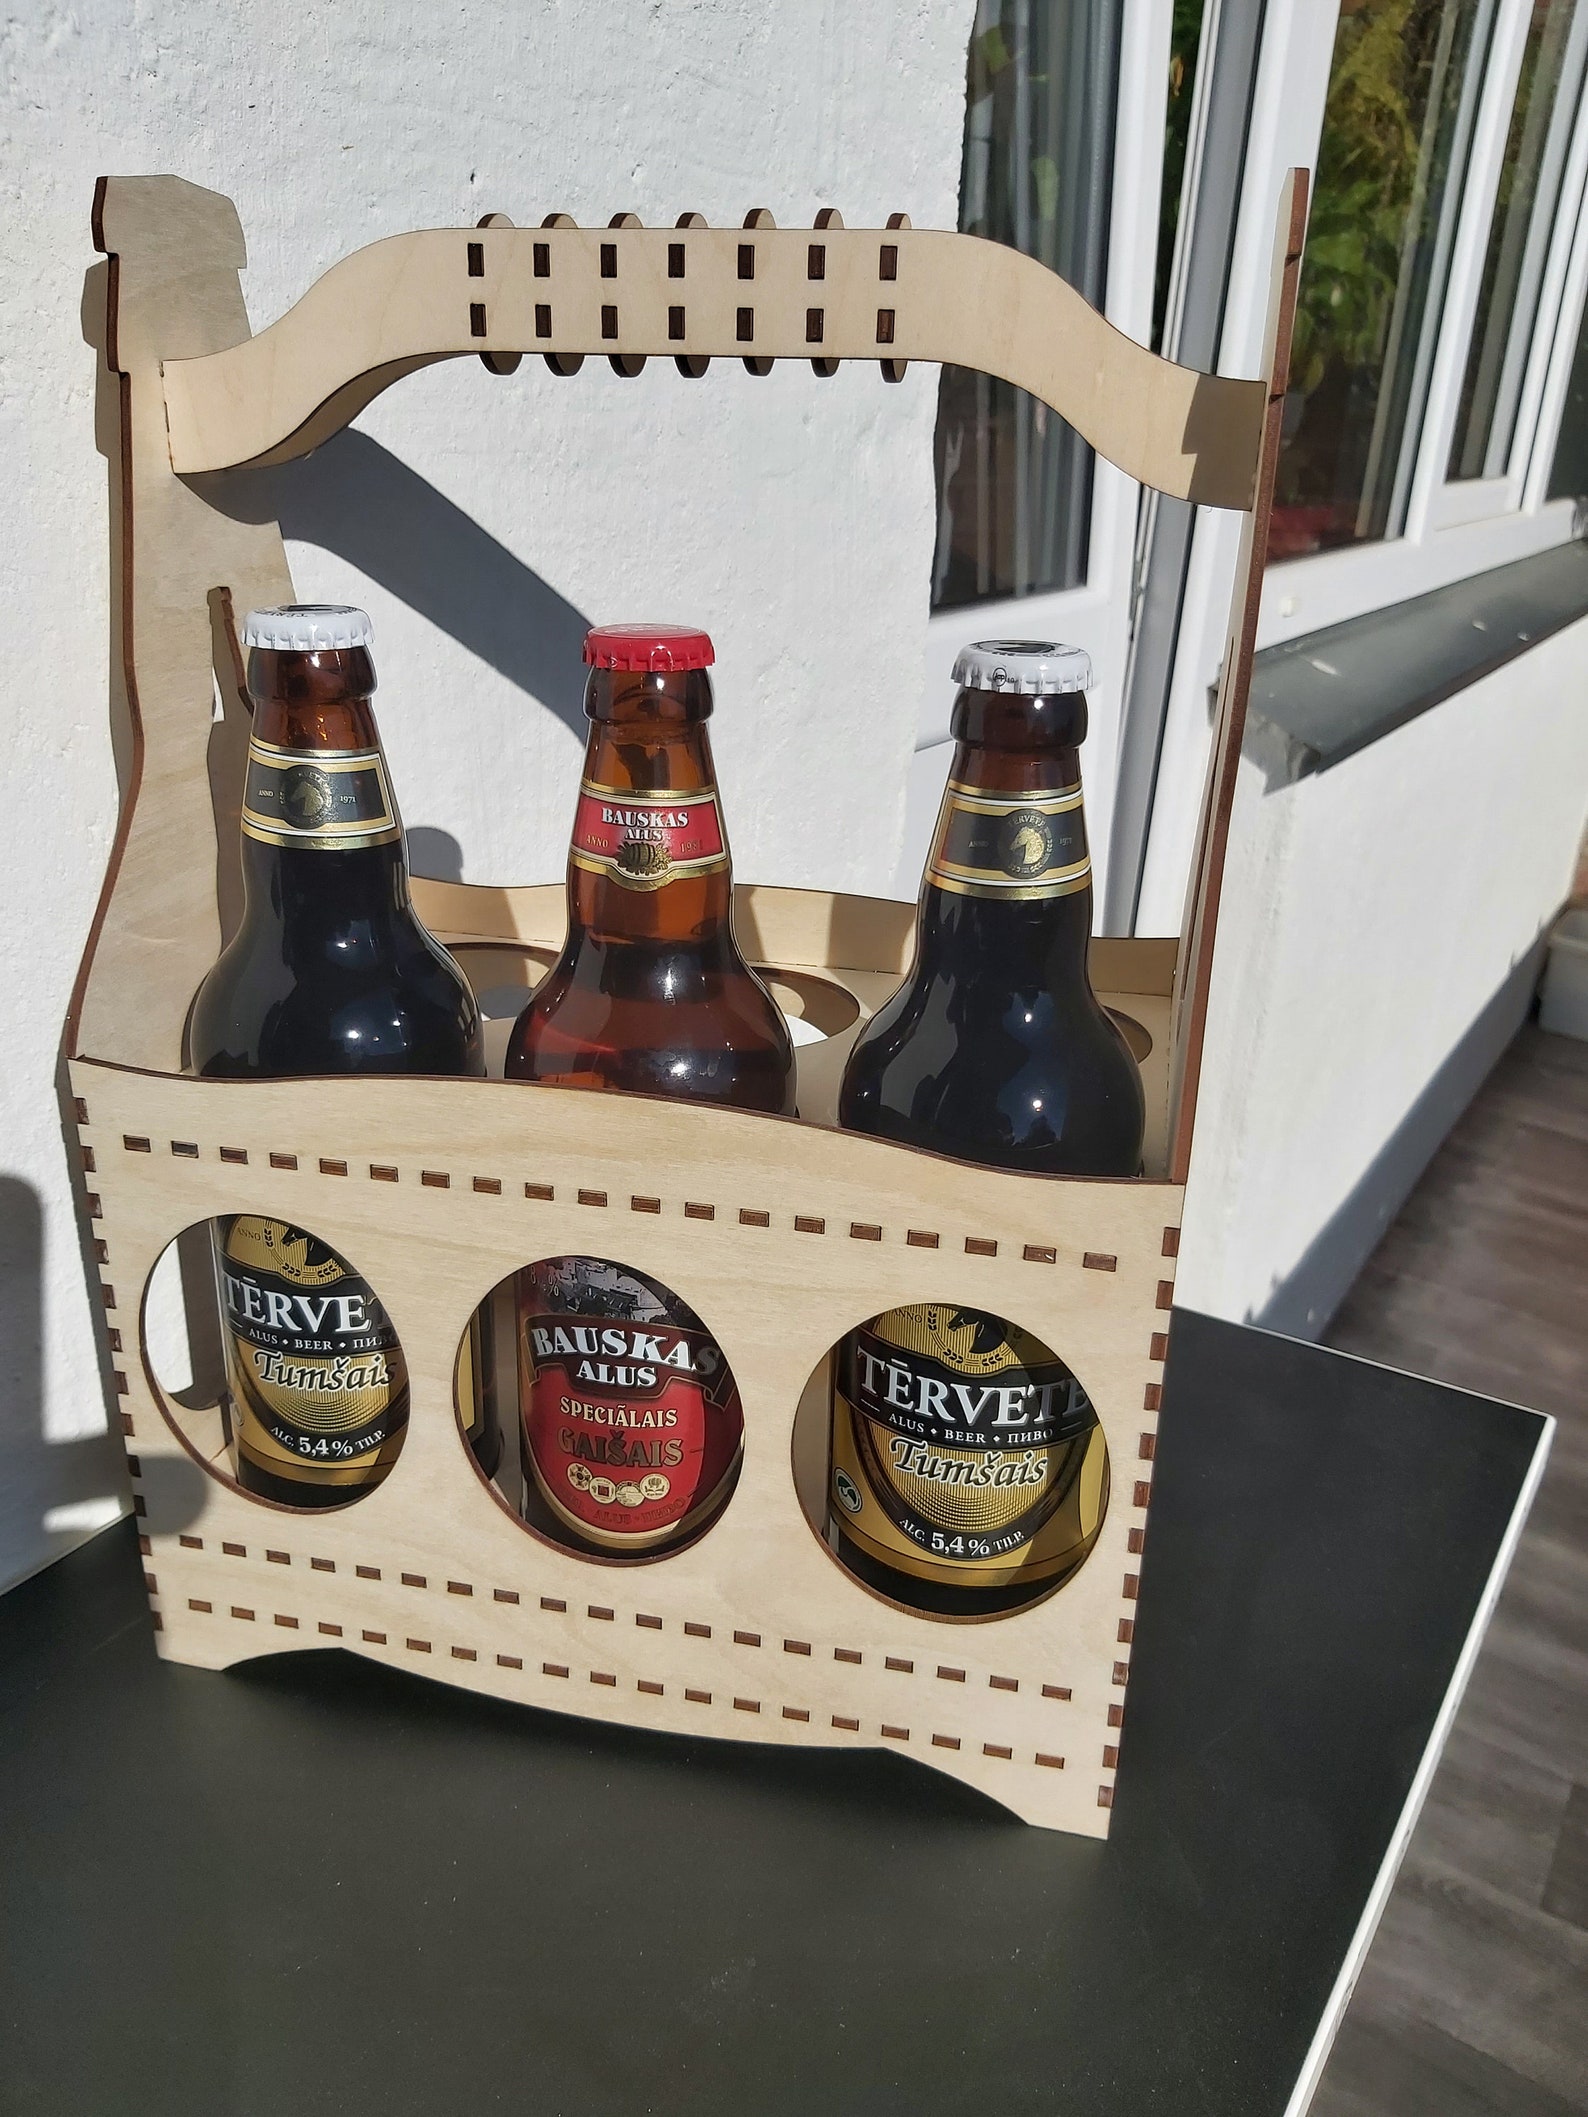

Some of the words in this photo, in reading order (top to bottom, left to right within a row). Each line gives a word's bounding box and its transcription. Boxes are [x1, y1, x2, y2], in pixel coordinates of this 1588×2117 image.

[340, 796, 356, 804] 1971
[601, 807, 689, 828] BAUSKAS
[586, 834, 609, 848] ANNO
[625, 828, 663, 841] ALUS
[237, 1227, 261, 1241] ANNO
[249, 1329, 278, 1345] ALUS
[295, 1339, 333, 1350] BEER
[531, 1326, 721, 1376] BAUSKAS
[253, 1350, 398, 1393] Tumšais
[576, 1360, 657, 1387] ALUS
[270, 1426, 295, 1448] ALC.
[355, 1429, 386, 1451] TILP.
[888, 1413, 925, 1433] ALUS
[944, 1428, 987, 1444] BEER
[1006, 1427, 1053, 1444] ПИВО
[557, 1426, 684, 1468] GAIŠAIS
[890, 1436, 1049, 1488] Tumšais
[899, 1518, 926, 1542] ALC.
[992, 1530, 1026, 1551] TILP.
